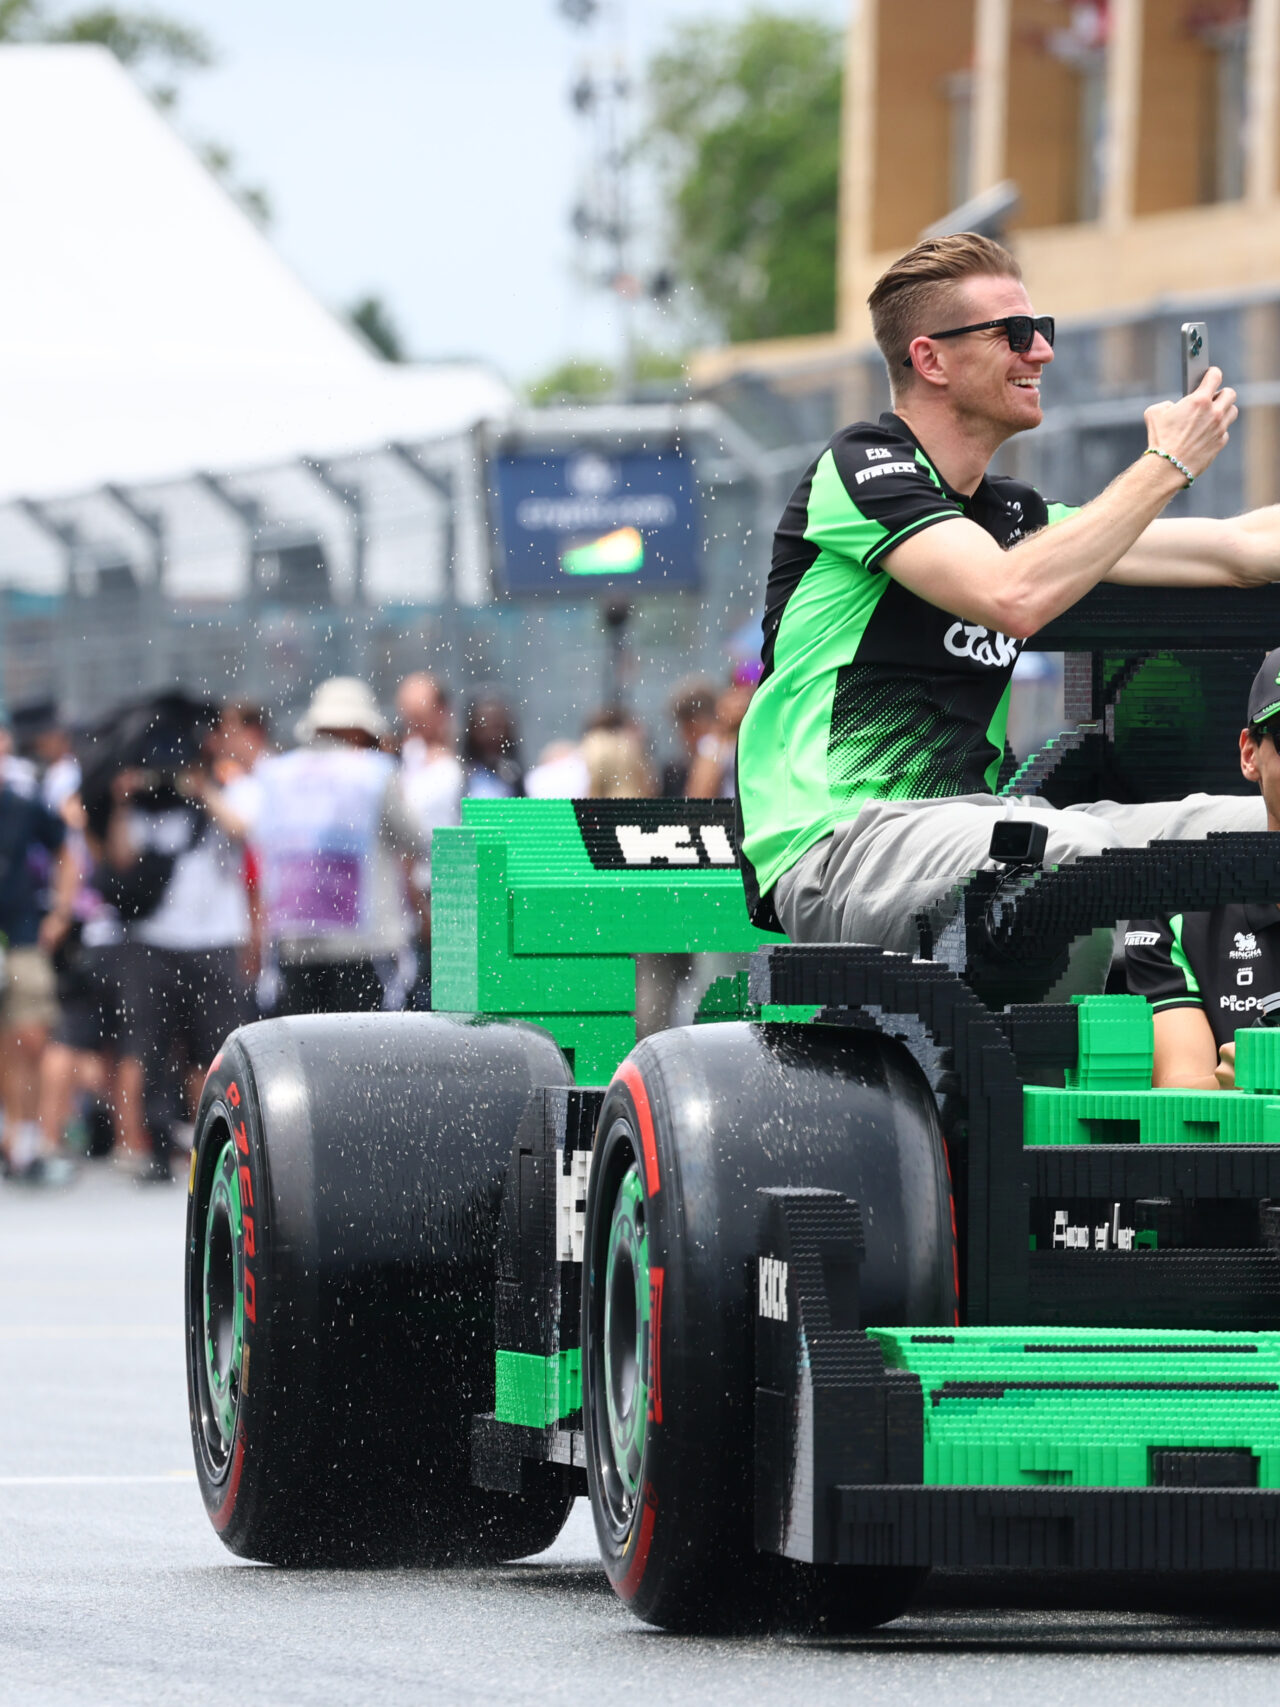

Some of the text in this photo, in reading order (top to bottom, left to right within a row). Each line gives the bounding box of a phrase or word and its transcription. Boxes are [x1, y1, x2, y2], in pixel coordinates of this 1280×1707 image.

[616, 826, 735, 864] KI
[1220, 995, 1264, 1011] PicPa
[226, 1081, 256, 1324] P ZERO
[759, 1256, 788, 1322] KICK
